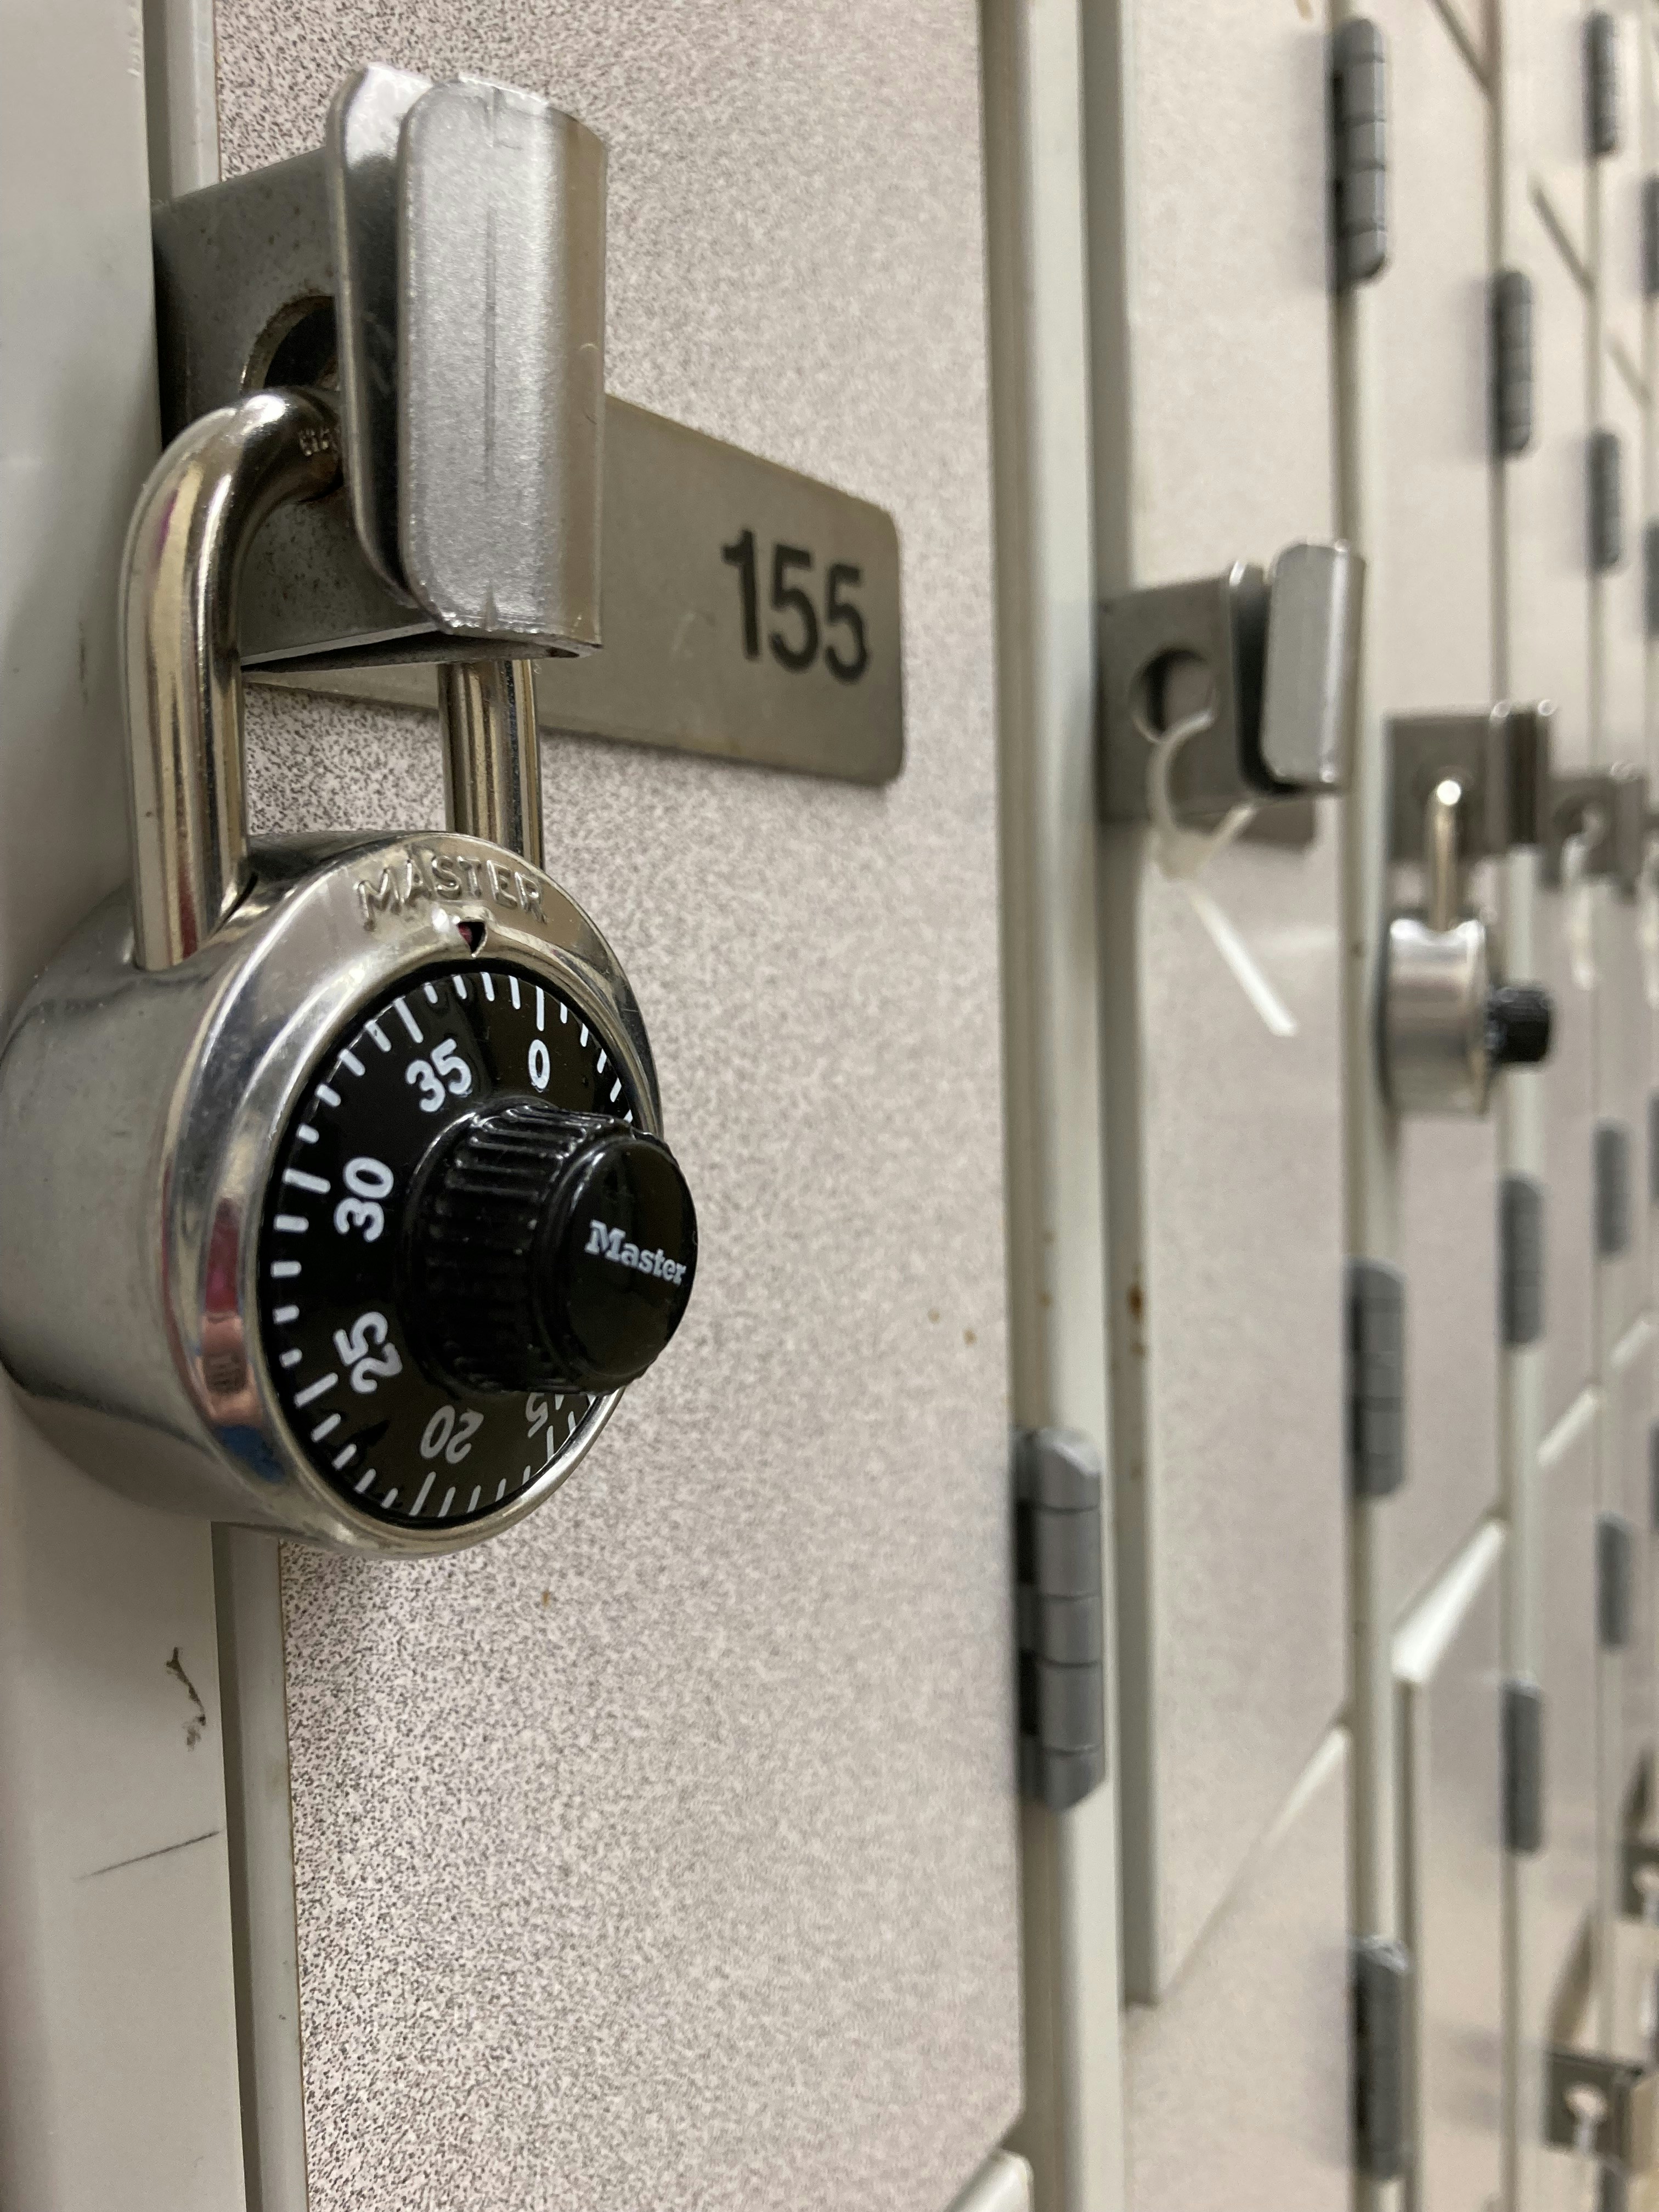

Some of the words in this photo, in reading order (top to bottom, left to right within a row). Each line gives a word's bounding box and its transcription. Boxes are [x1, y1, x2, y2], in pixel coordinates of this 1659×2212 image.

[721, 528, 869, 685] 155
[356, 850, 548, 931] MASTER
[405, 1038, 472, 1113] 35
[528, 1039, 550, 1092] 0
[334, 1156, 395, 1242] 30
[584, 1219, 686, 1287] Master
[334, 1311, 403, 1393] 25
[419, 1404, 484, 1464] 20
